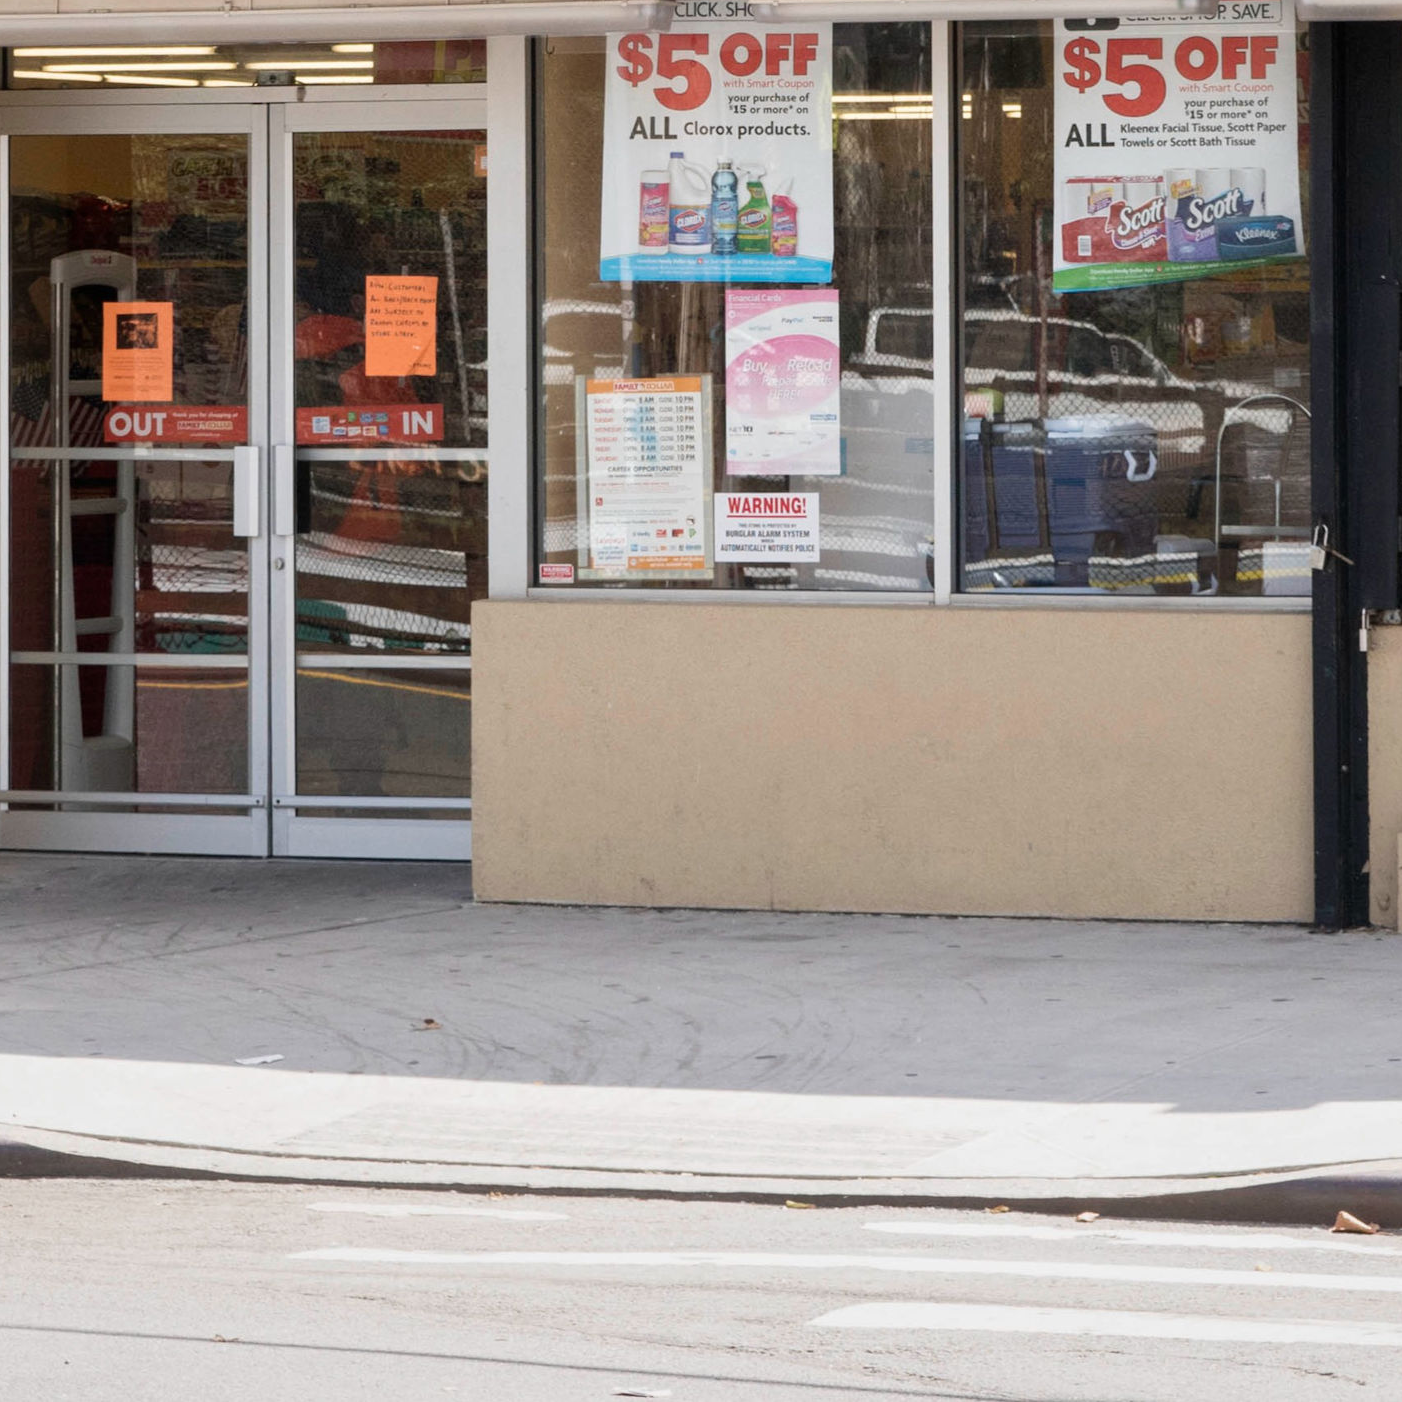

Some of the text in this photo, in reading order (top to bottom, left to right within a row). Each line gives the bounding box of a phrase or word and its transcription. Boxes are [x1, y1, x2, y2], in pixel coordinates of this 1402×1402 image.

[675, 2, 722, 18] CLICK.
[1232, 4, 1275, 19] SAVE.
[616, 32, 819, 111] $5 OFF
[1063, 35, 1279, 117] $5 OFF
[723, 79, 815, 90] with Smart Coupon
[1179, 83, 1275, 95] with Smart Coupon
[728, 92, 810, 104] your purchase of
[1184, 96, 1269, 110] your purchase of
[729, 105, 747, 114] $15
[1185, 110, 1204, 119] $15
[1255, 111, 1269, 119] on
[629, 116, 811, 140] ALL Clorox products.
[1064, 123, 1115, 148] ALL
[1120, 123, 1159, 134] Kleenex
[1162, 123, 1189, 134] Facial
[1227, 122, 1254, 133] Scott
[1257, 122, 1287, 135] Paper
[1120, 136, 1256, 148] Towels or Scott Bath Tissue
[1187, 188, 1241, 229] Scott
[1117, 198, 1165, 236] Scott
[1235, 227, 1279, 243] Kleenex
[728, 294, 782, 302] Financial Cards
[742, 358, 833, 374] Buy Reload
[109, 411, 167, 437] OUT
[402, 410, 434, 436] IN
[727, 497, 807, 514] WARNING!
[725, 530, 811, 538] BURGLAR ALARM SYSTEM
[720, 544, 815, 552] AUTOMATICALLY NOTIFIES POLICE
